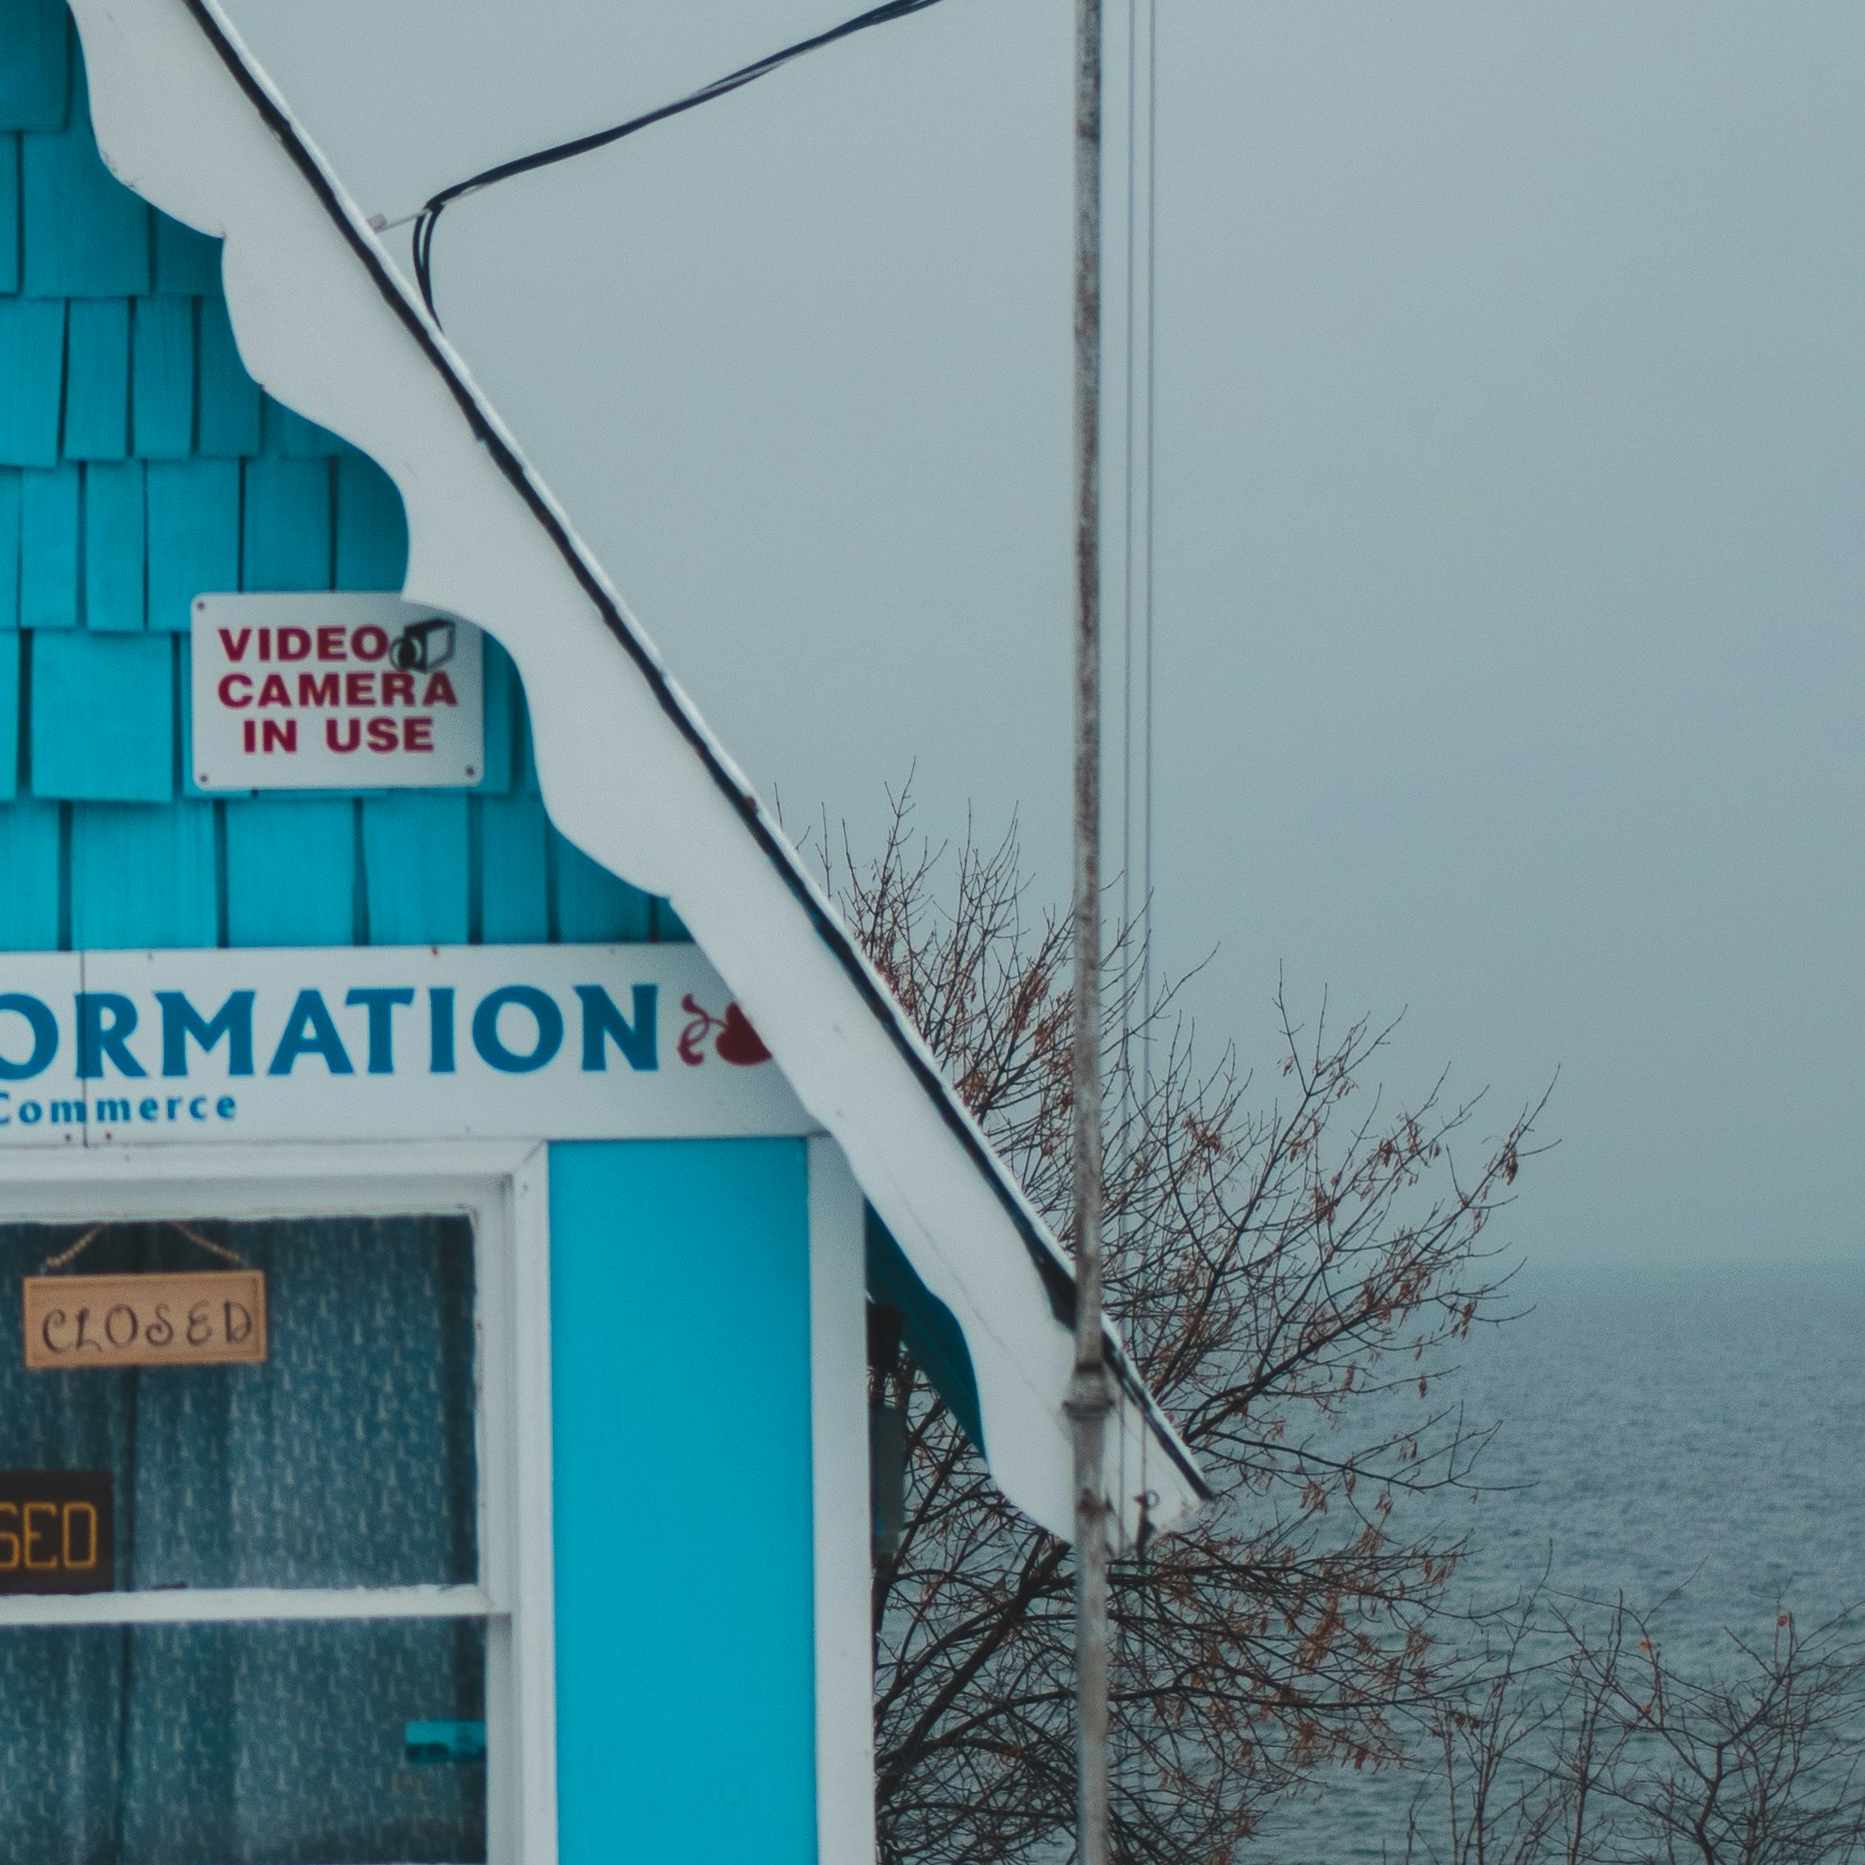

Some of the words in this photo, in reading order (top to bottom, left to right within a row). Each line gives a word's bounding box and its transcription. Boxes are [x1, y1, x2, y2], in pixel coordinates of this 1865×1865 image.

[217, 624, 389, 663] VIDEO
[217, 671, 458, 709] CAMERA
[243, 719, 298, 754] IN
[325, 716, 434, 754] USE
[41, 1300, 253, 1354] CLOSED
